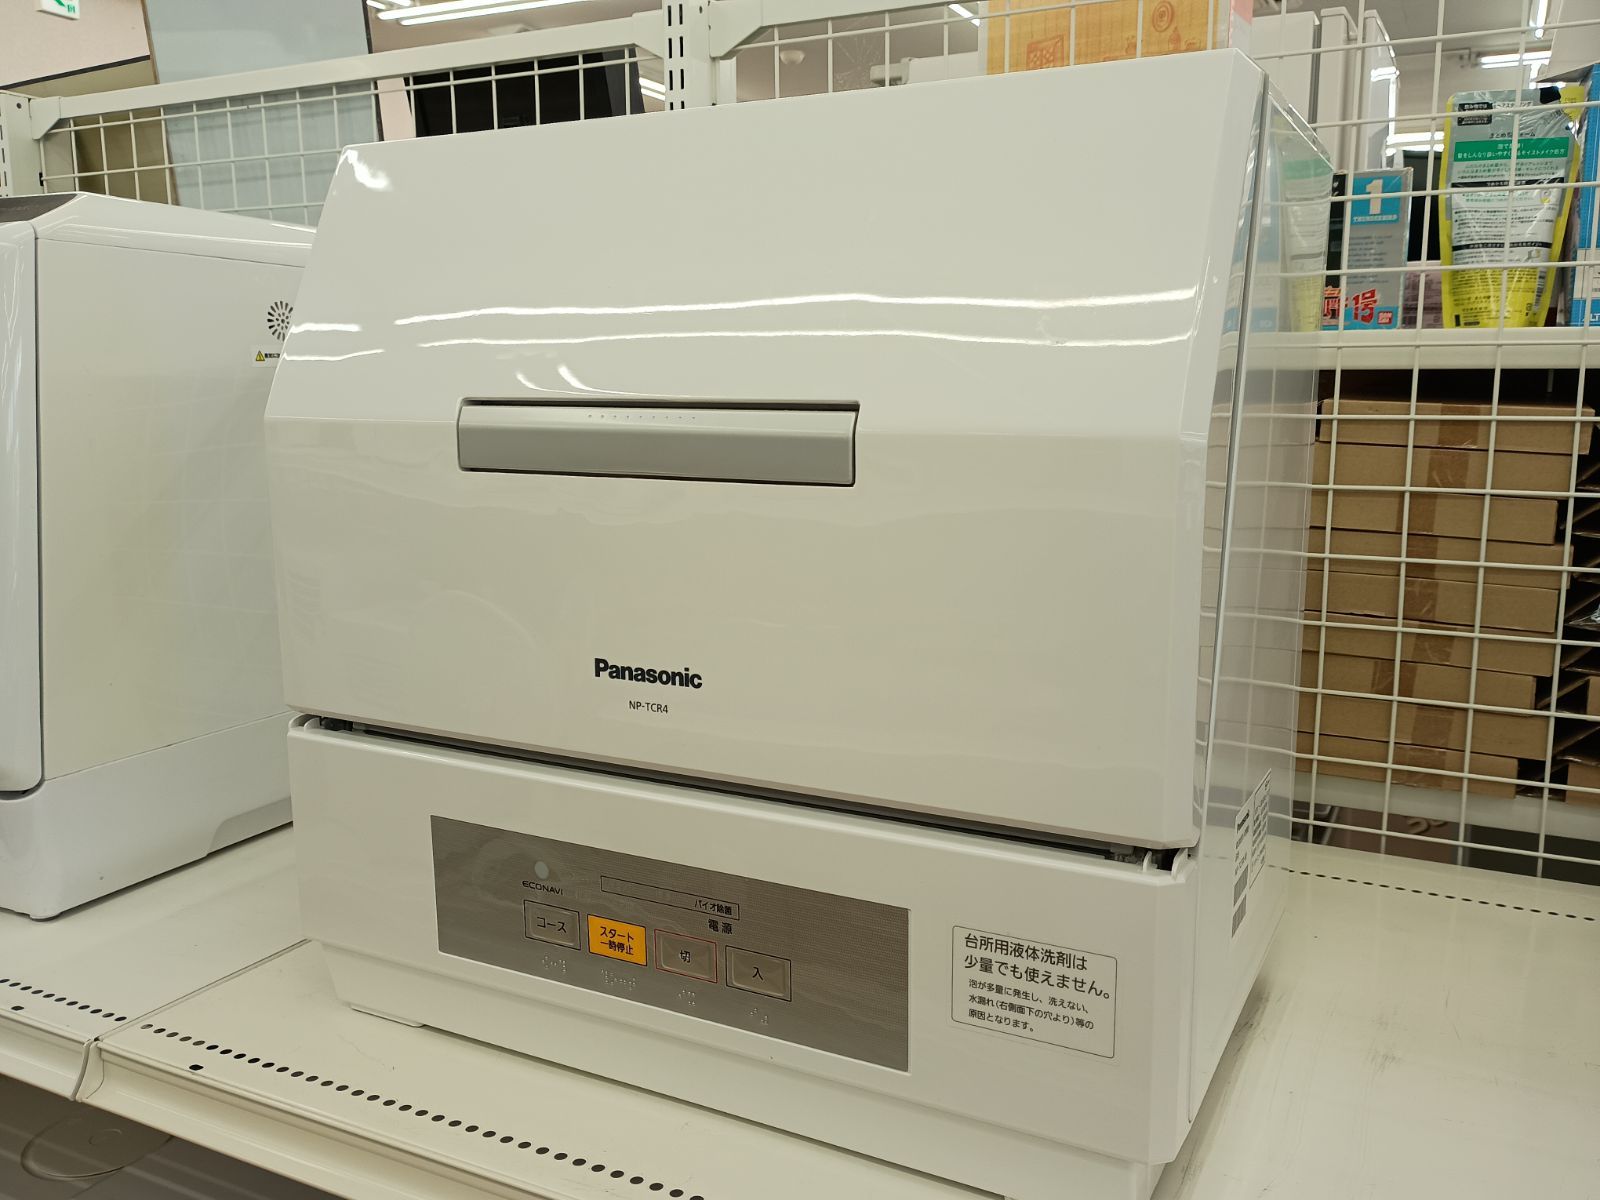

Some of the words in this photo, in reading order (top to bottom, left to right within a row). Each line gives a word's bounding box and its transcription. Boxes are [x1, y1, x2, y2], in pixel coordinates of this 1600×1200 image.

[1366, 178, 1384, 215] 1
[594, 657, 703, 689] Panasonic
[628, 700, 668, 714] NP-TCR4
[522, 880, 564, 896] ECONAVI
[694, 899, 732, 915] バイオ除菌
[536, 915, 567, 934] コース
[708, 918, 733, 935] 電源
[600, 926, 634, 943] スタート
[600, 939, 634, 956] 一時停止
[679, 949, 691, 963] 切
[964, 933, 1088, 971] 台所用液体洗剤は
[752, 966, 765, 981] 入
[964, 954, 1110, 1000] 少量でも使えません。
[968, 978, 1089, 1014] 泡が多量に発生し、洗えない、
[968, 1008, 1034, 1033] 原因となります。
